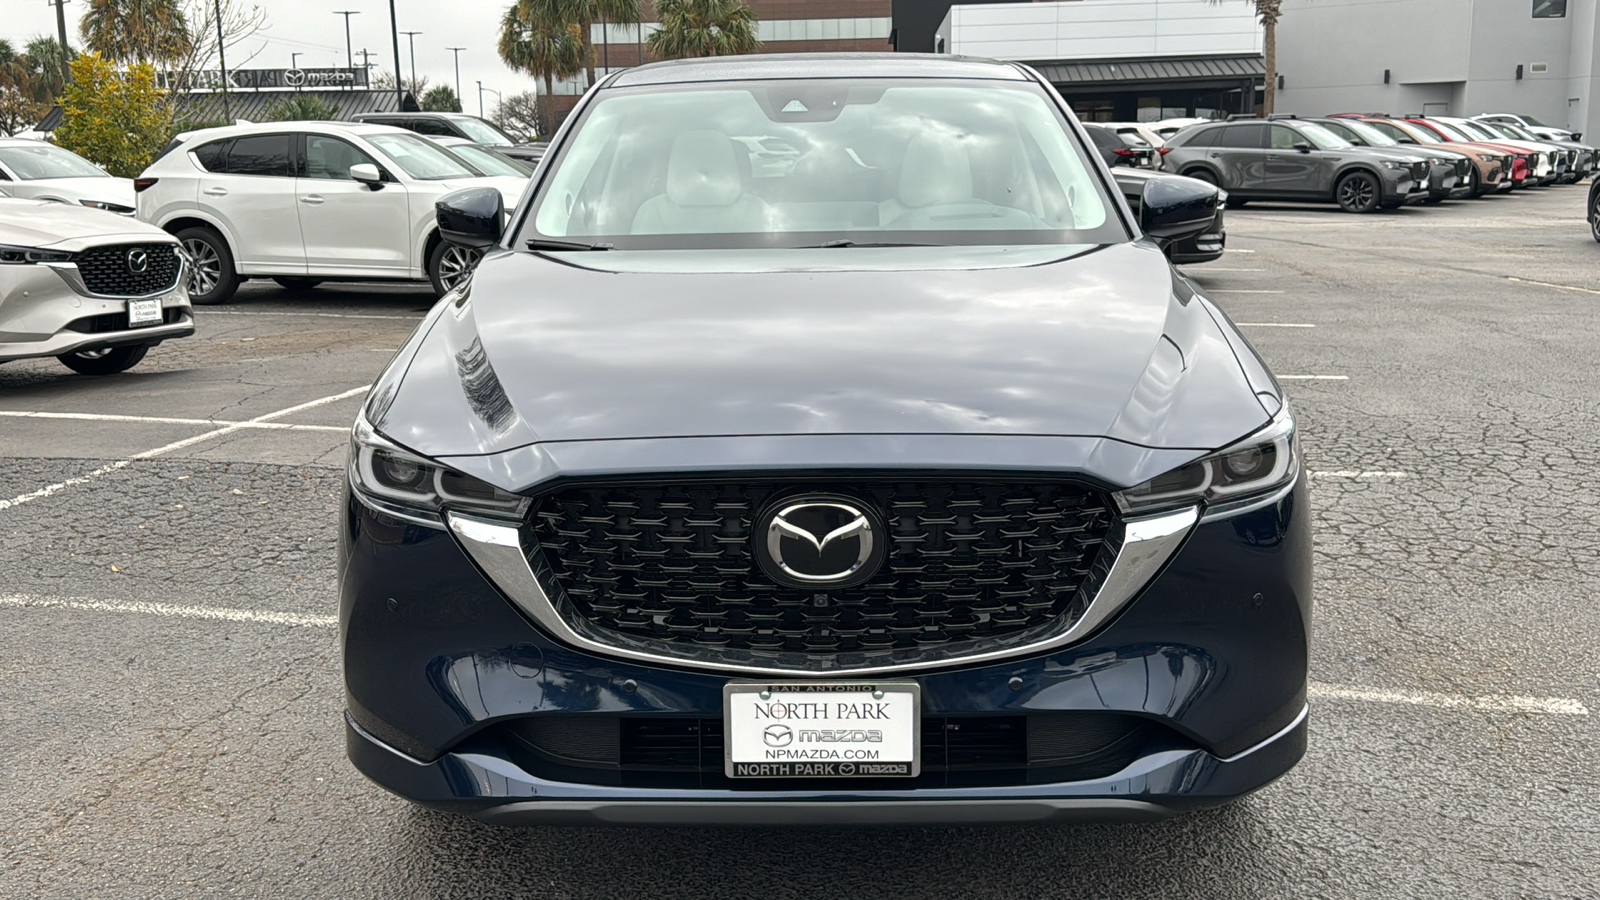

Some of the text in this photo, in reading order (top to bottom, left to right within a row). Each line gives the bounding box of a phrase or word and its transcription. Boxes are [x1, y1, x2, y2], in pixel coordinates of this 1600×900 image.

[754, 702, 891, 720] NORTH PARK
[765, 749, 879, 760] NPMAZDA.COM
[737, 763, 791, 776] NORTH
[794, 763, 835, 775] PARK
